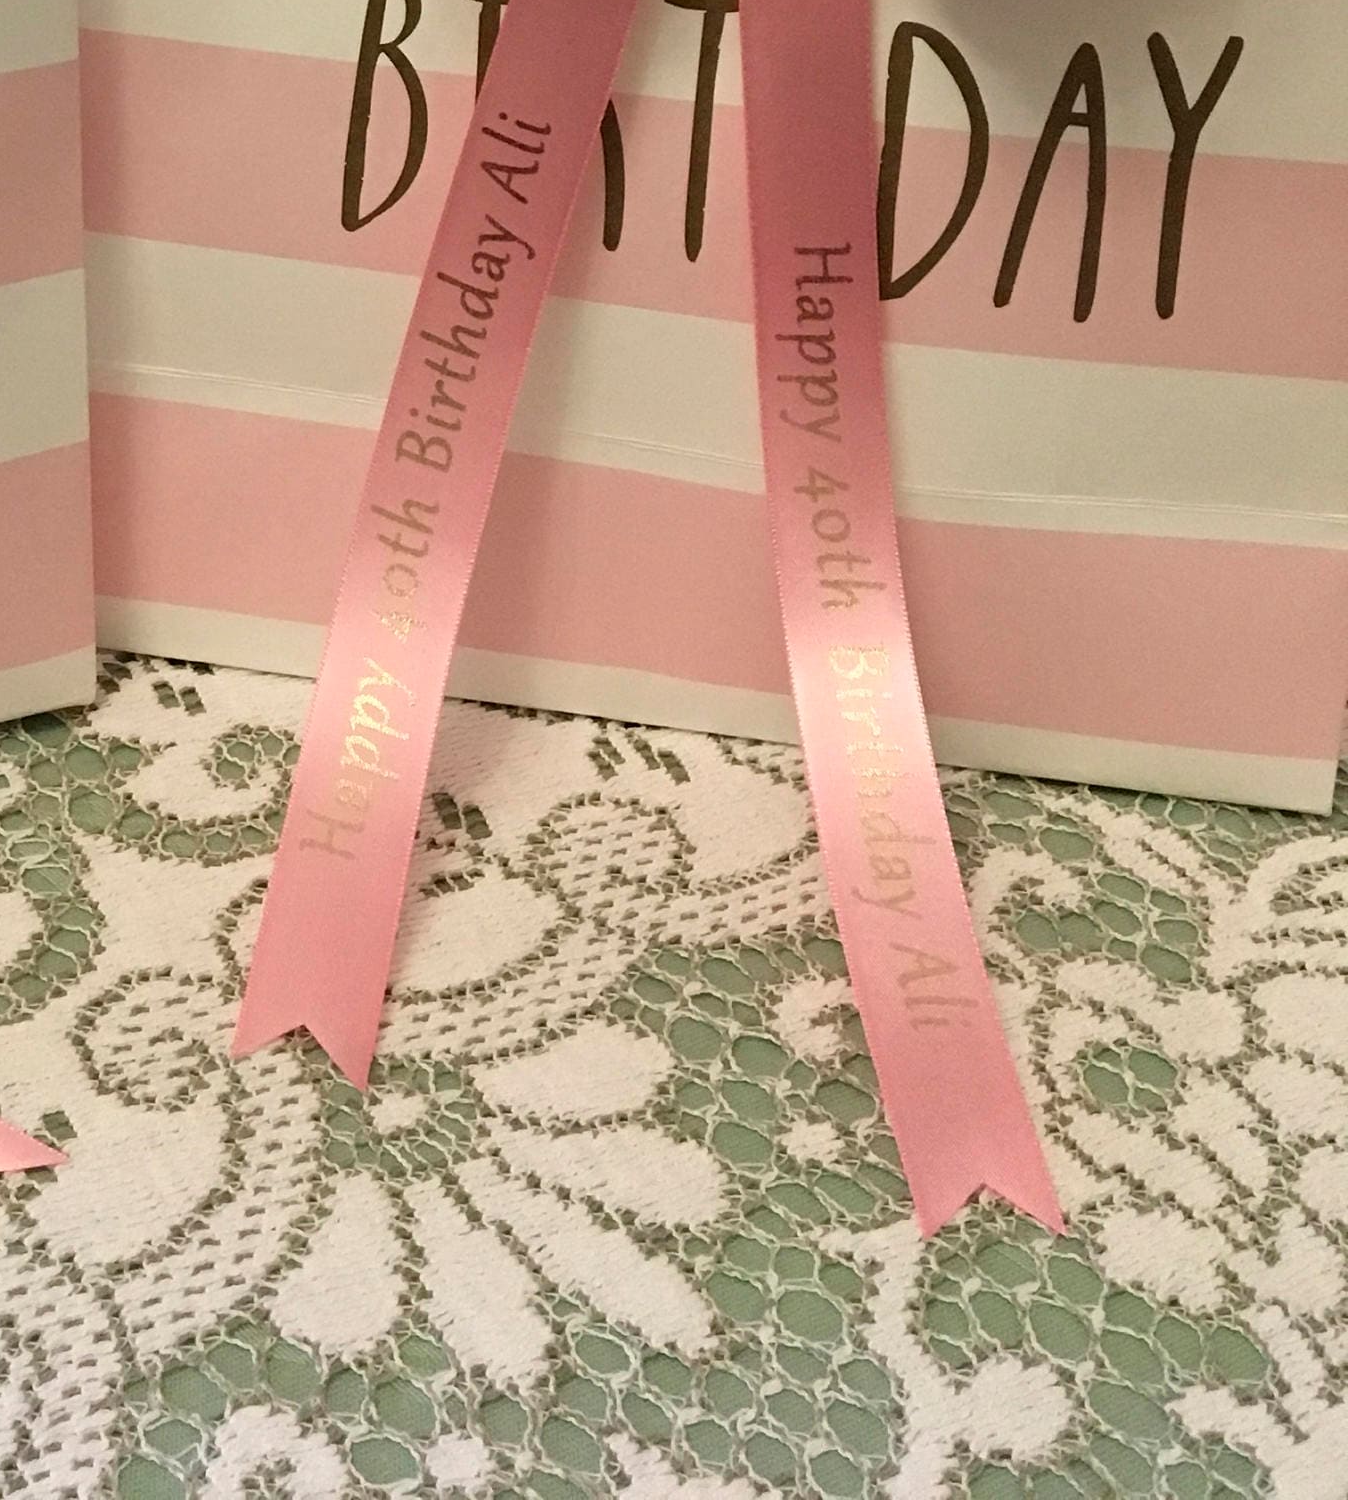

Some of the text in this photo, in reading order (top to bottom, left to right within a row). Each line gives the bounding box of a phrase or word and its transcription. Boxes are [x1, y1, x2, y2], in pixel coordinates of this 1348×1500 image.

[299, 657, 416, 860] Happy
[395, 213, 535, 474] Birthday
[480, 111, 552, 204] Ali
[774, 242, 980, 1030] Happy 40th Birthday Ali
